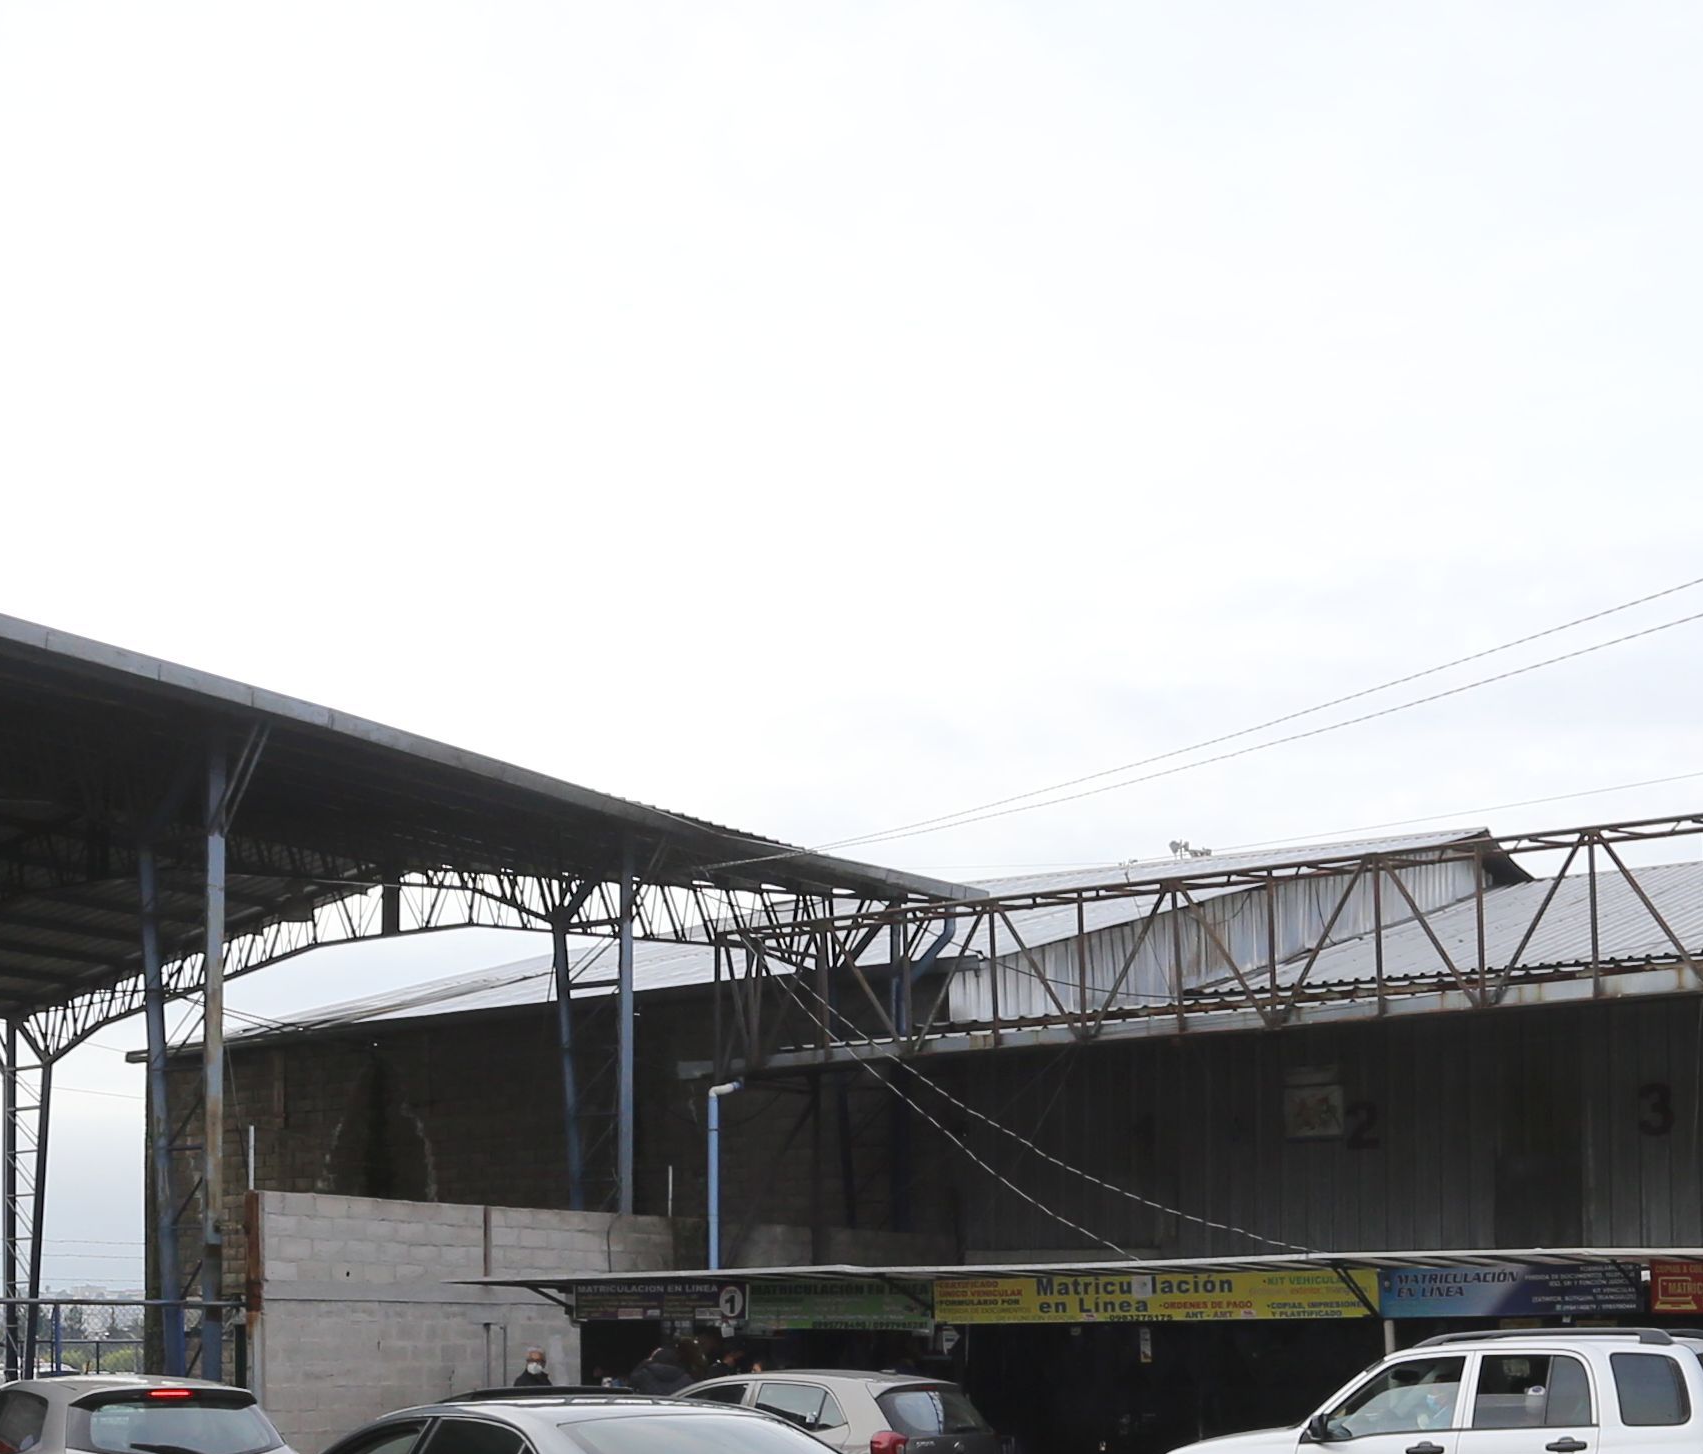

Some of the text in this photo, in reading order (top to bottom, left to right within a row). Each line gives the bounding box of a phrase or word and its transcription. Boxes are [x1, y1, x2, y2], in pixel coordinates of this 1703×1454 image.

[1638, 1083, 1674, 1135] 3
[1347, 1101, 1379, 1150] 2
[1397, 1269, 1518, 1285] MATRICULACIÓN
[971, 1289, 1023, 1298] VEHICULAR
[1397, 1287, 1416, 1298] EN
[724, 1294, 737, 1315] 1
[939, 1298, 1020, 1307] FORMULARIO POR
[1038, 1296, 1148, 1314] en Línea
[1163, 1300, 1253, 1310] ORDENES DE PAGO
